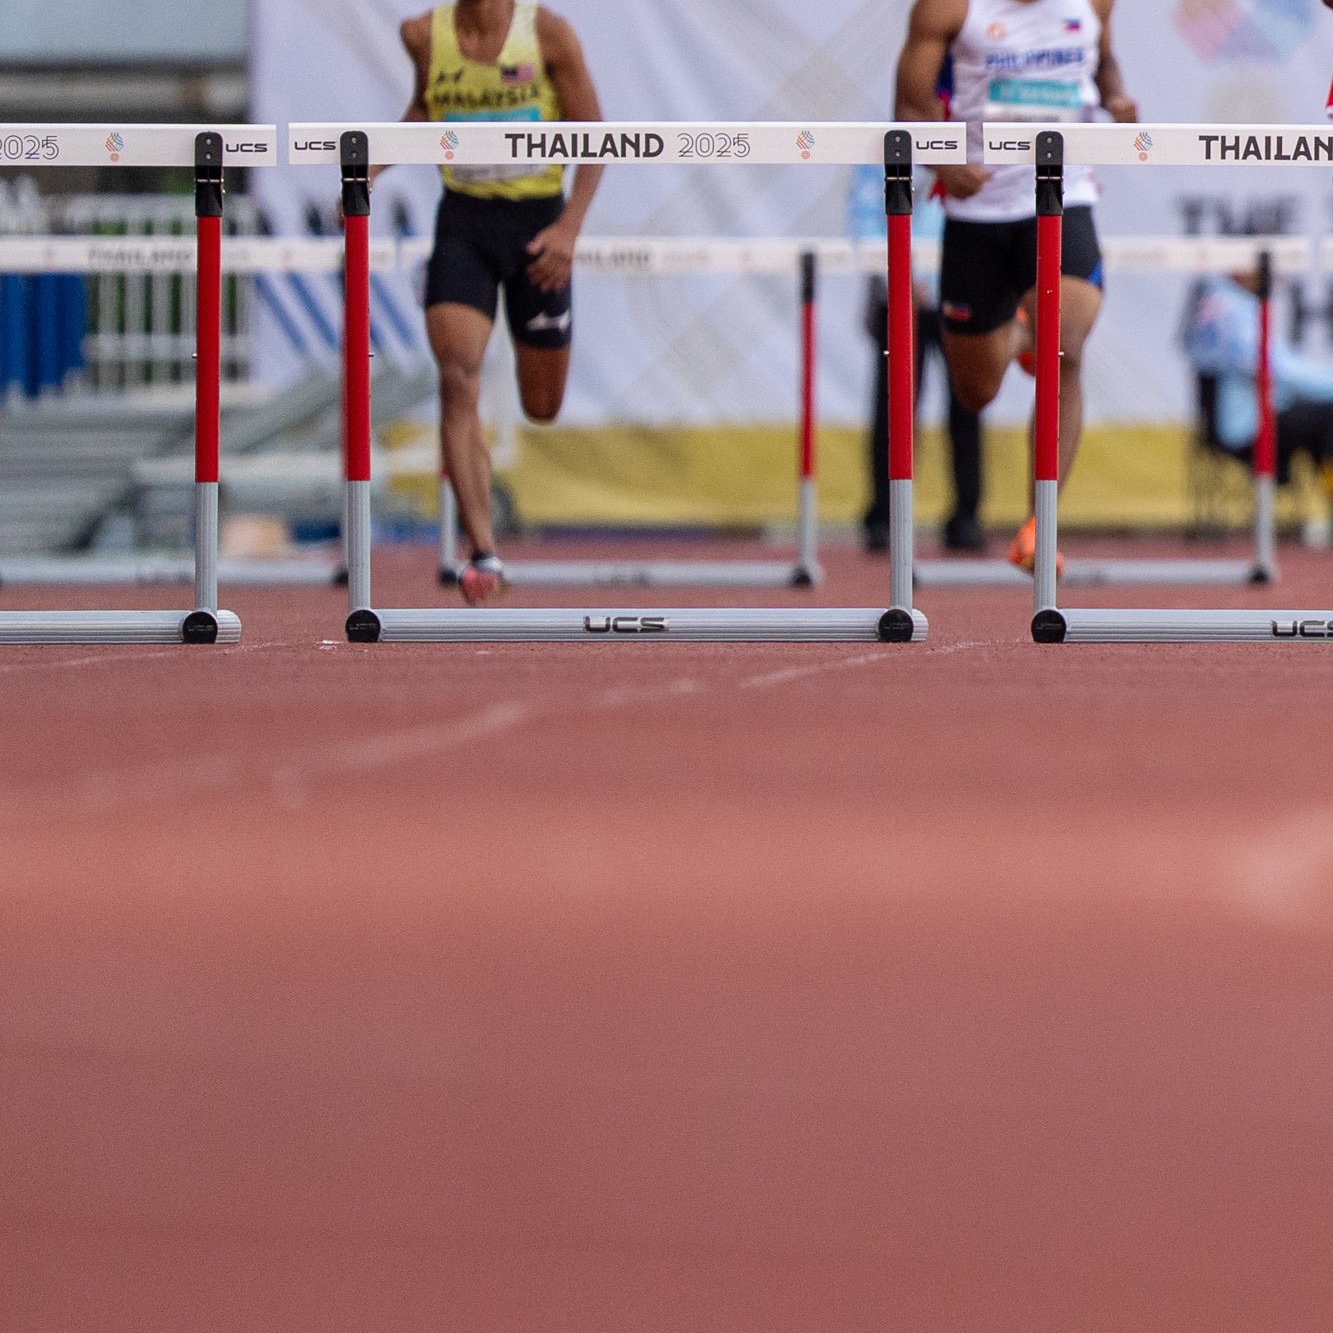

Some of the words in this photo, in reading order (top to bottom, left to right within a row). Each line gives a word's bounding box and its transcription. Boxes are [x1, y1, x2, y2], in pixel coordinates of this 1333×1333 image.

[0, 135, 60, 160] 025
[225, 143, 268, 153] UCS
[294, 141, 336, 151] UCS
[505, 133, 664, 158] THAILAND
[677, 133, 751, 158] 2025
[916, 140, 958, 150] UCS
[989, 141, 1031, 151] UCS
[584, 616, 667, 633] UCS
